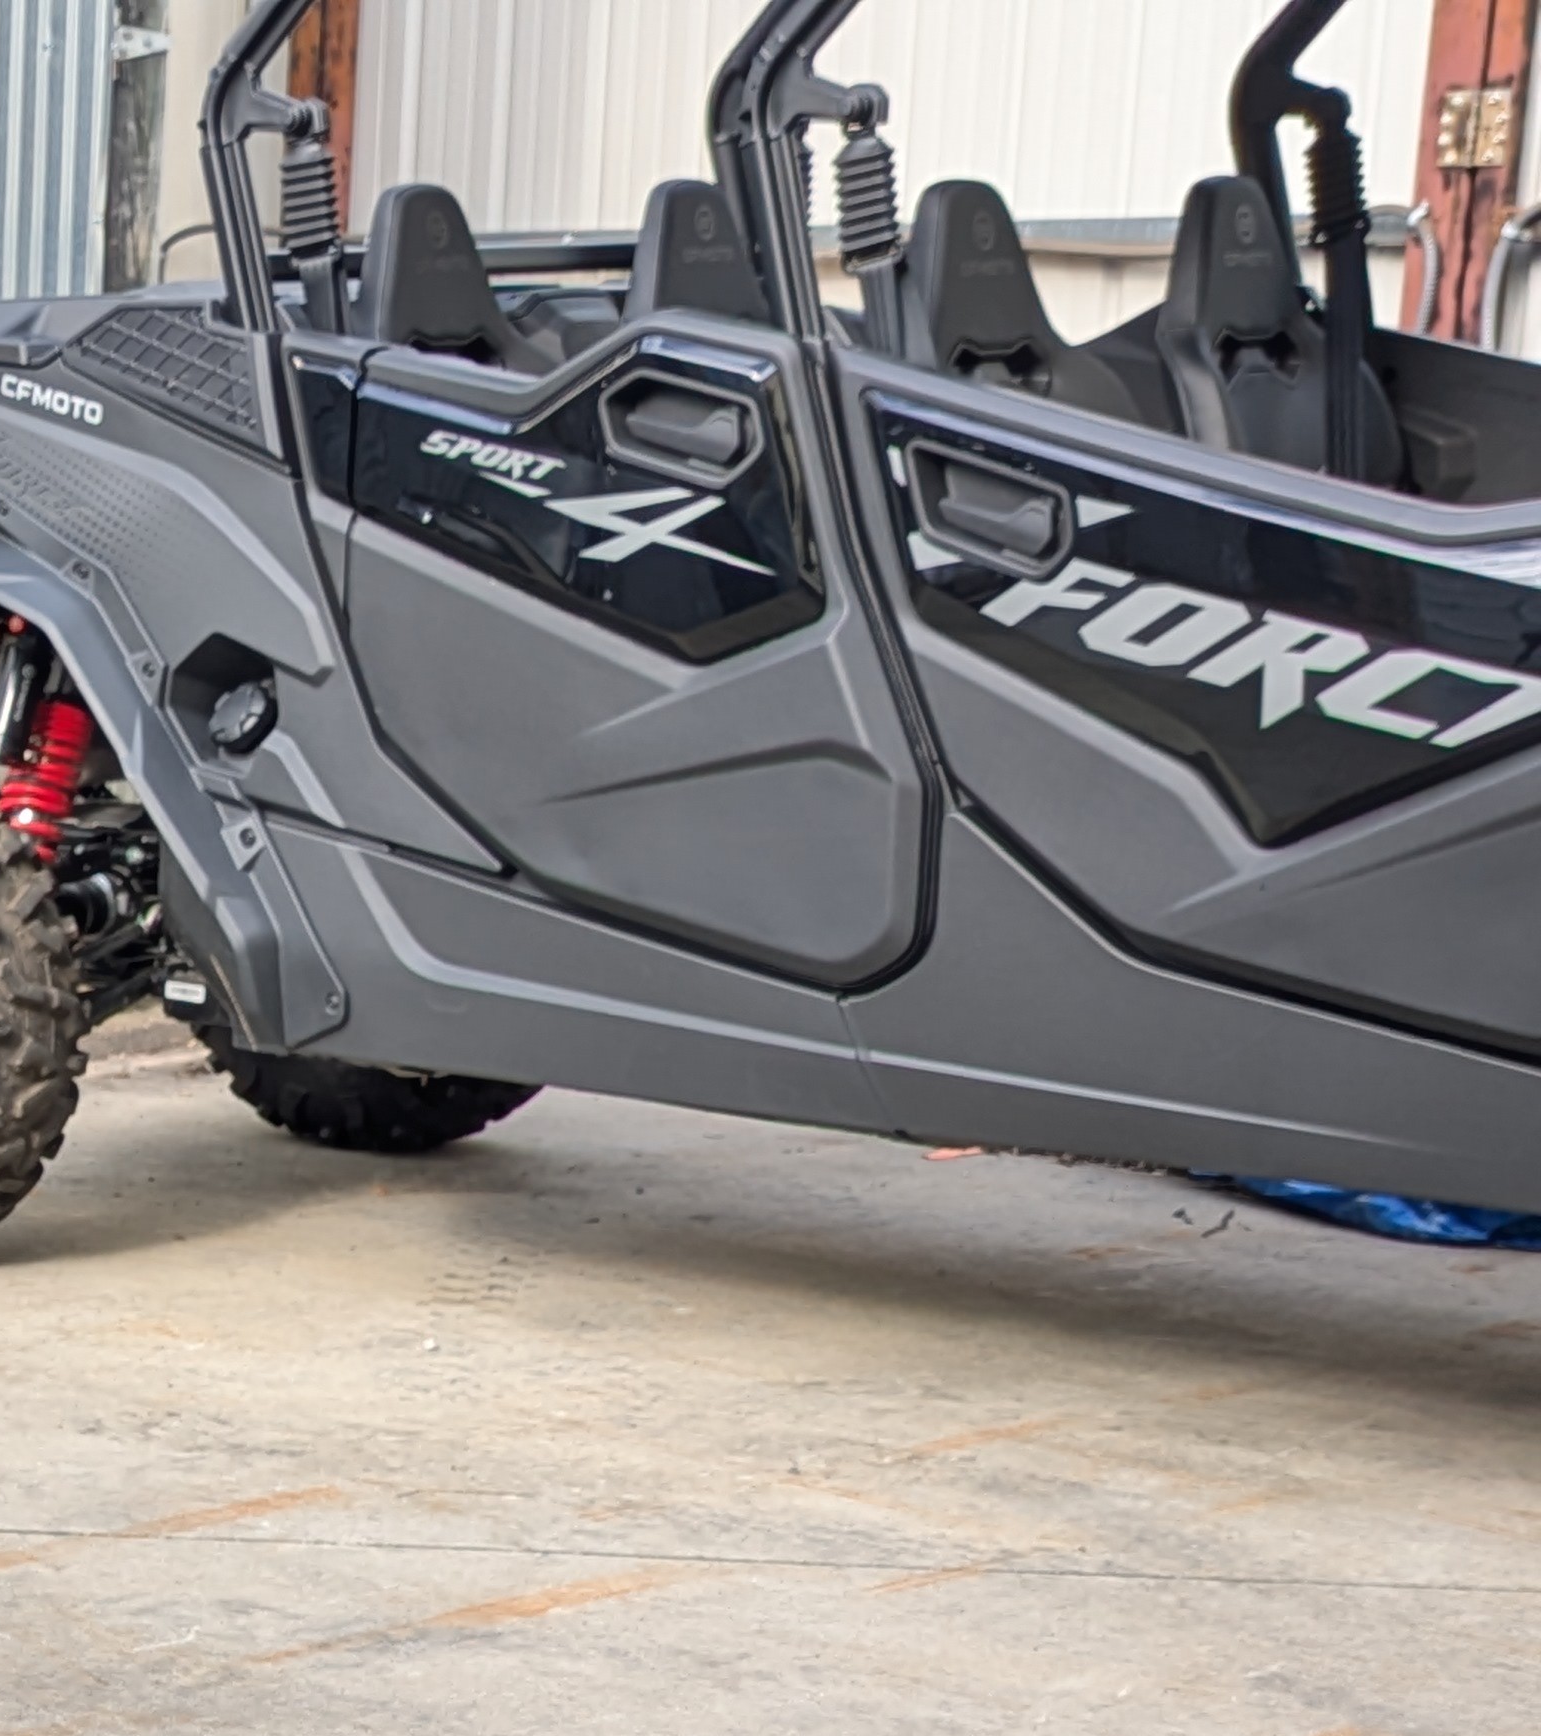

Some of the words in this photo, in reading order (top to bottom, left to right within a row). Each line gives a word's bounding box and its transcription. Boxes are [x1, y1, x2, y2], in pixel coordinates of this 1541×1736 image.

[0, 373, 104, 426] CFMOTO
[419, 428, 566, 482] SPORT
[543, 486, 775, 577] 4
